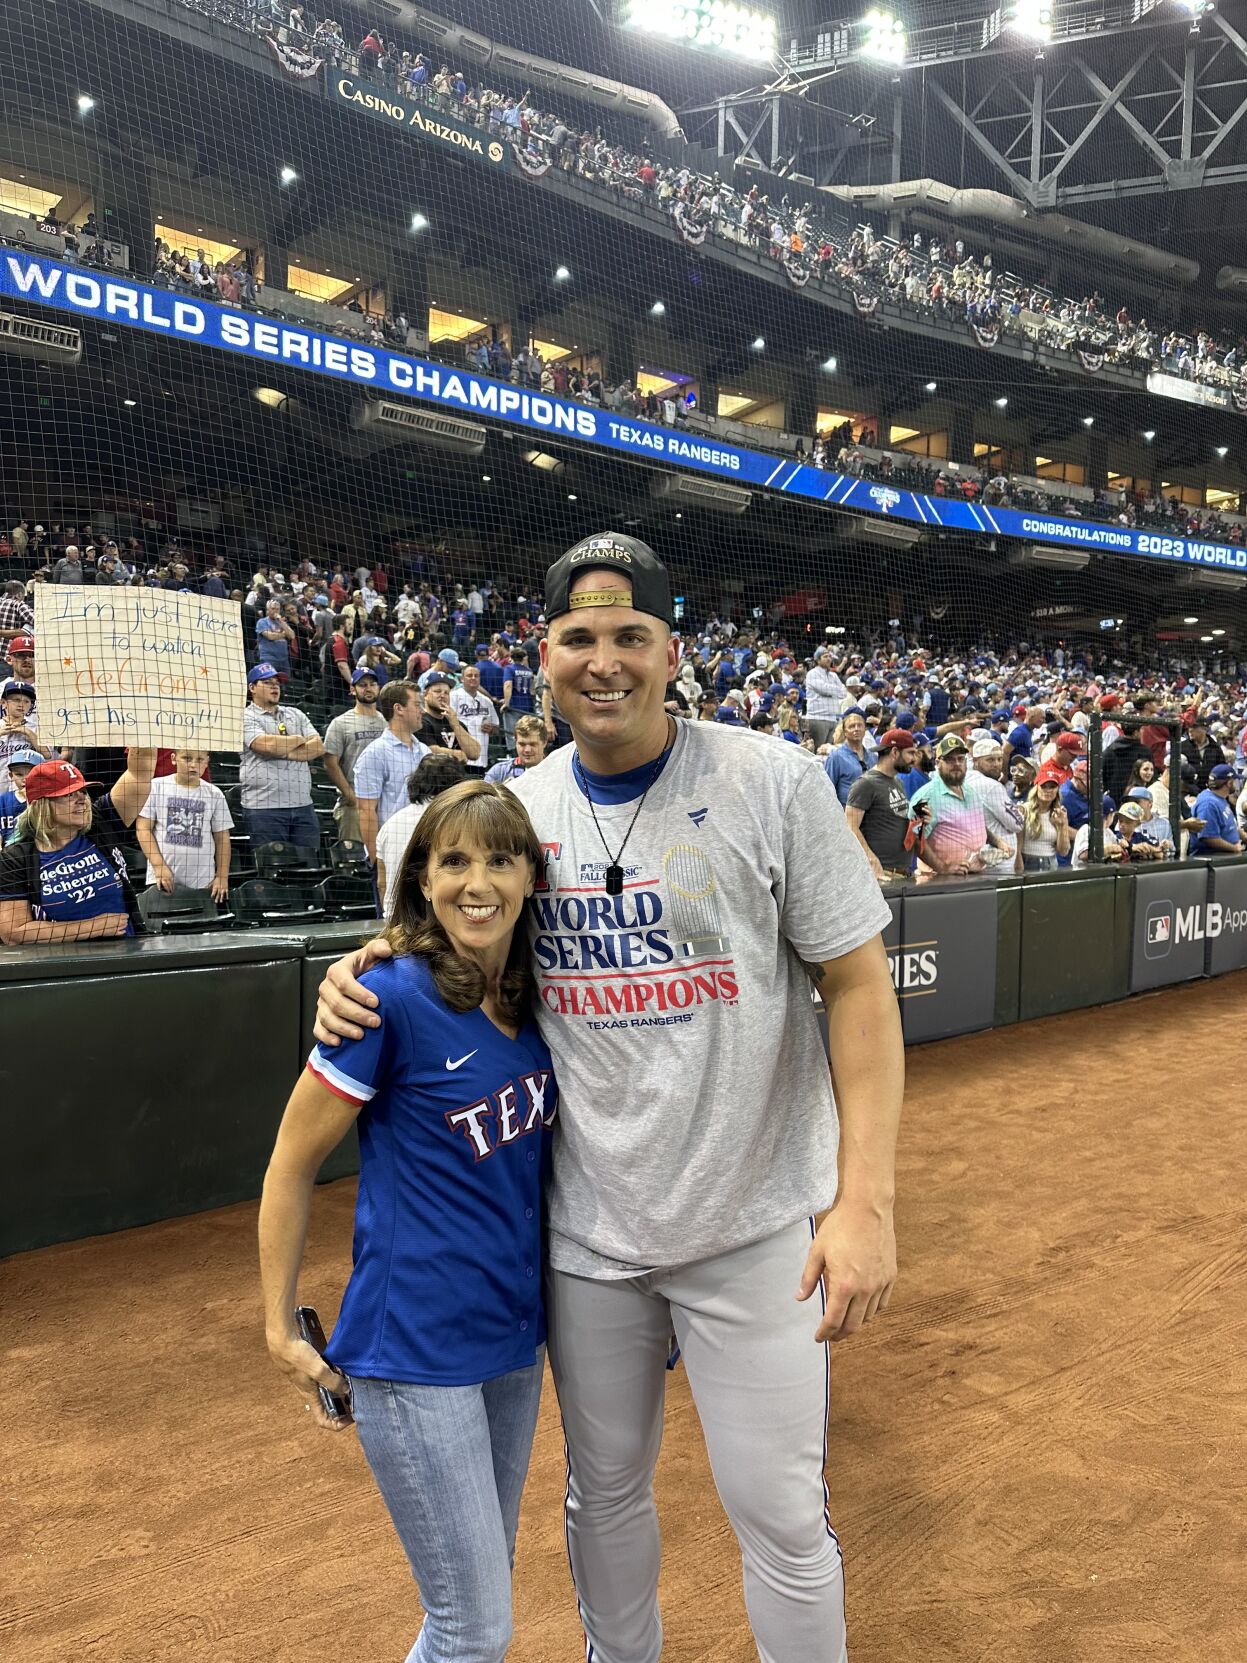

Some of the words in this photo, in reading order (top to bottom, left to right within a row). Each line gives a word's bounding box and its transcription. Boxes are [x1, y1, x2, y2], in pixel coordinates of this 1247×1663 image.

[338, 79, 405, 121] CASINO
[409, 110, 484, 155] ARIZONA
[40, 223, 57, 235] 203
[6, 256, 206, 335] WORLD
[221, 313, 377, 379] SERIES
[388, 358, 597, 437] CHAMPIONS
[608, 422, 665, 451] TEXAS
[668, 438, 741, 470] RANGERS
[570, 548, 632, 563] CHAMPS
[1022, 518, 1132, 547] CONGRATULATIONS
[1137, 534, 1185, 558] 2023
[1187, 542, 1247, 567] WORLD
[132, 600, 180, 632] just
[197, 606, 239, 633] here
[104, 628, 129, 650] to
[143, 635, 202, 657] watch
[49, 704, 90, 737] get
[107, 704, 137, 727] his
[60, 763, 77, 779] T
[40, 851, 101, 882] deGrom
[42, 867, 110, 896] Scherzer
[580, 872, 602, 881] FALL
[67, 886, 96, 904] '22
[531, 891, 664, 931] WORLD
[1174, 902, 1223, 944] MLB
[1223, 906, 1247, 933] App
[534, 929, 674, 970] SERIES
[887, 950, 939, 989] IES
[541, 971, 739, 1016] CHAMPIONS
[586, 1019, 629, 1030] TEXAS
[630, 1014, 693, 1028] RANGERS
[446, 1070, 559, 1162] TEX
